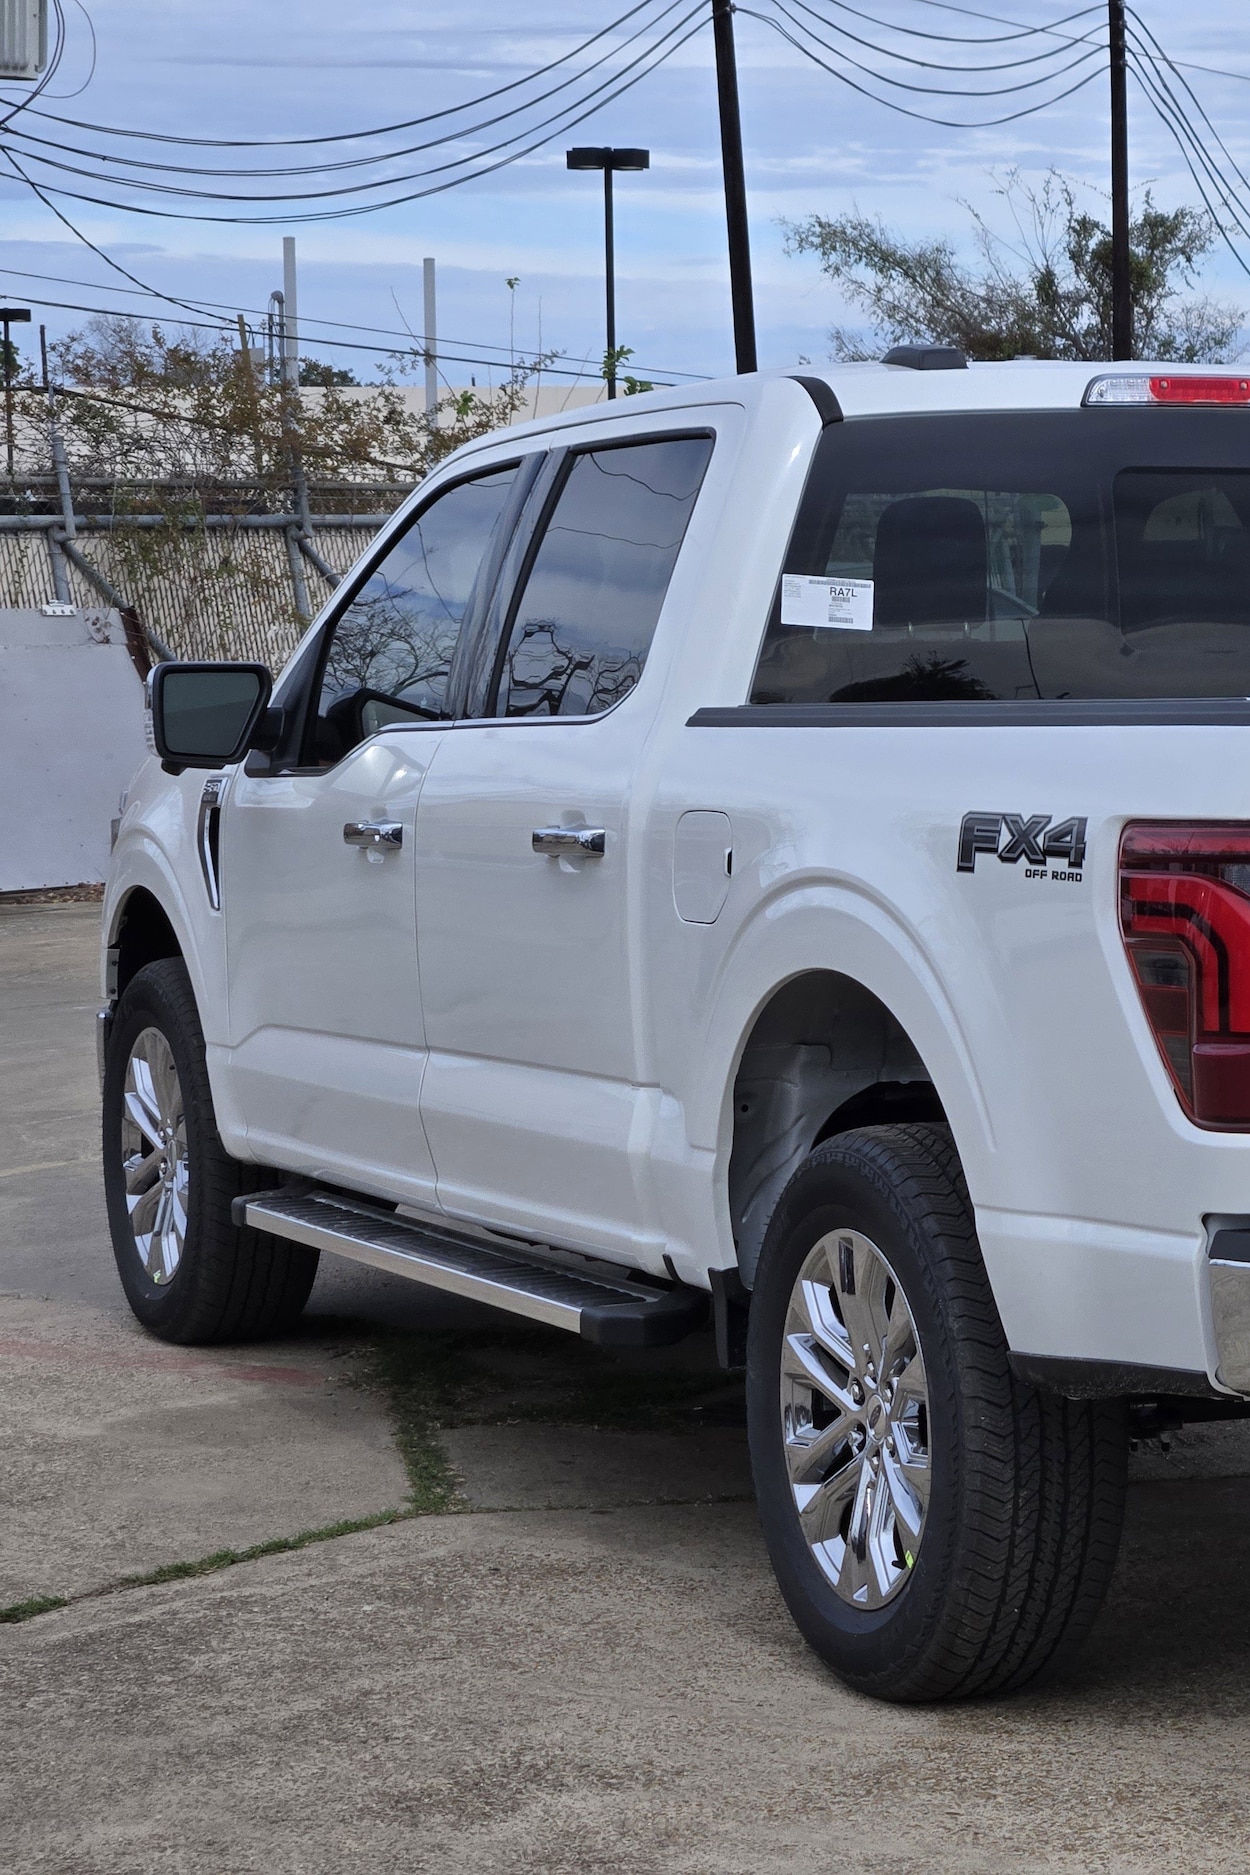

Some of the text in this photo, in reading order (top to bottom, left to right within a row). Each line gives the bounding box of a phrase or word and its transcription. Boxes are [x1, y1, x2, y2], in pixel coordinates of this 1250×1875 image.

[829, 586, 858, 598] RA7L
[956, 810, 1088, 873] FX4
[1025, 868, 1083, 883] OFF ROAD
